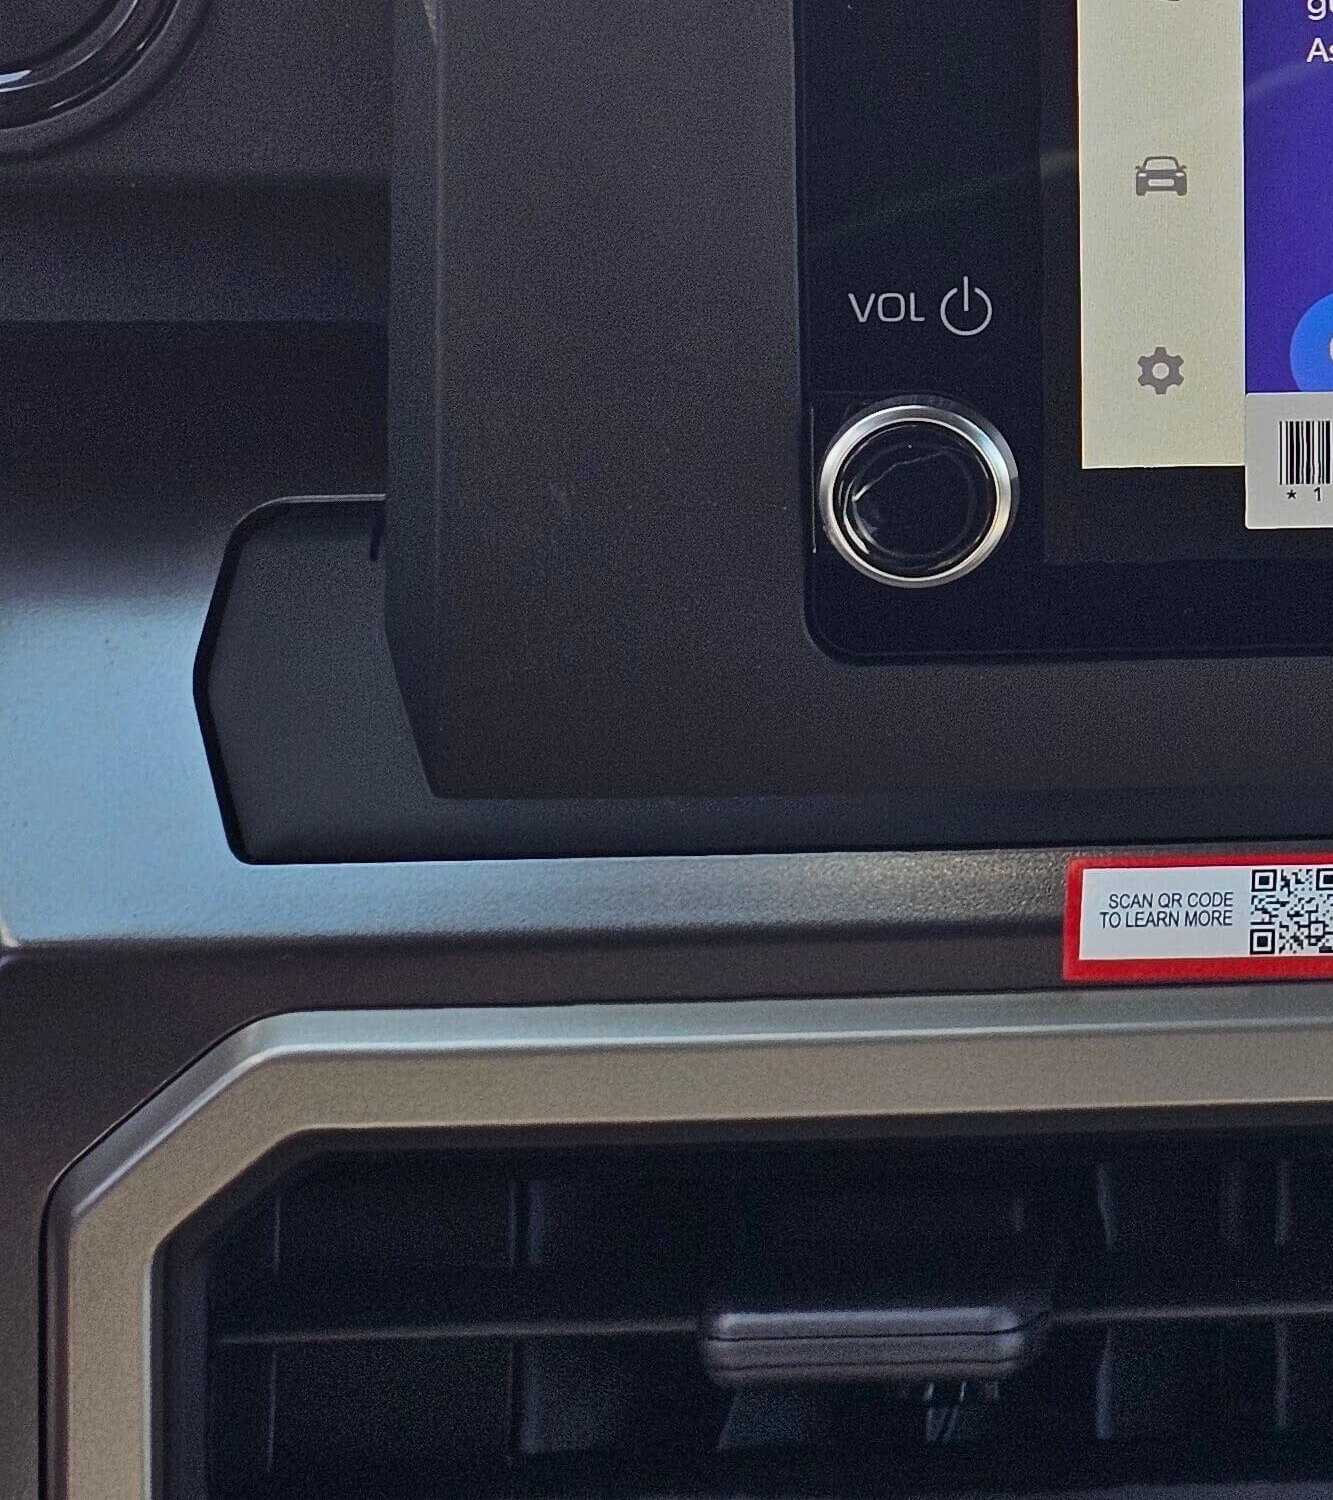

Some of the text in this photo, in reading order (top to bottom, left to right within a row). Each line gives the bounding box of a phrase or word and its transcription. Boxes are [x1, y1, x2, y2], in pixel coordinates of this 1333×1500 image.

[848, 292, 925, 323] VOL
[1108, 891, 1234, 909] SCAN QR CODE
[1099, 910, 1233, 928] TO LEARN MORE
